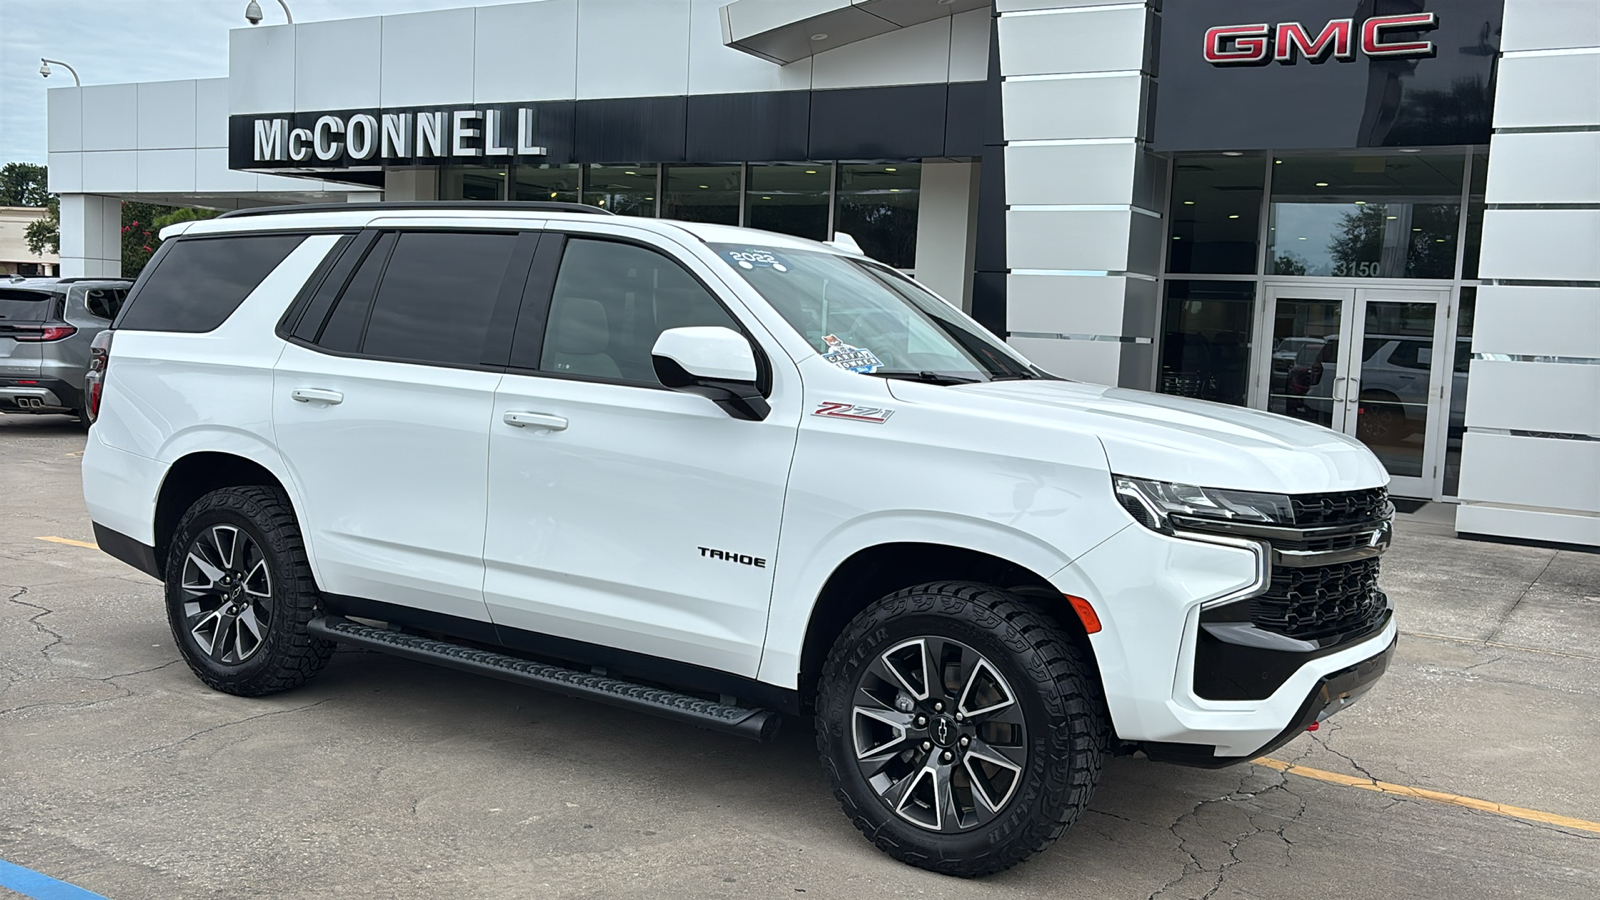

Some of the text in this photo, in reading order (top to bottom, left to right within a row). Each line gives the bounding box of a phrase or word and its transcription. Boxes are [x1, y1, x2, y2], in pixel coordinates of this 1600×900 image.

[1204, 12, 1438, 65] GMC
[254, 107, 547, 162] McCONNELL
[729, 251, 779, 264] 2022
[1336, 260, 1381, 277] 3150
[814, 401, 894, 424] Z71
[698, 547, 766, 568] TAHOE
